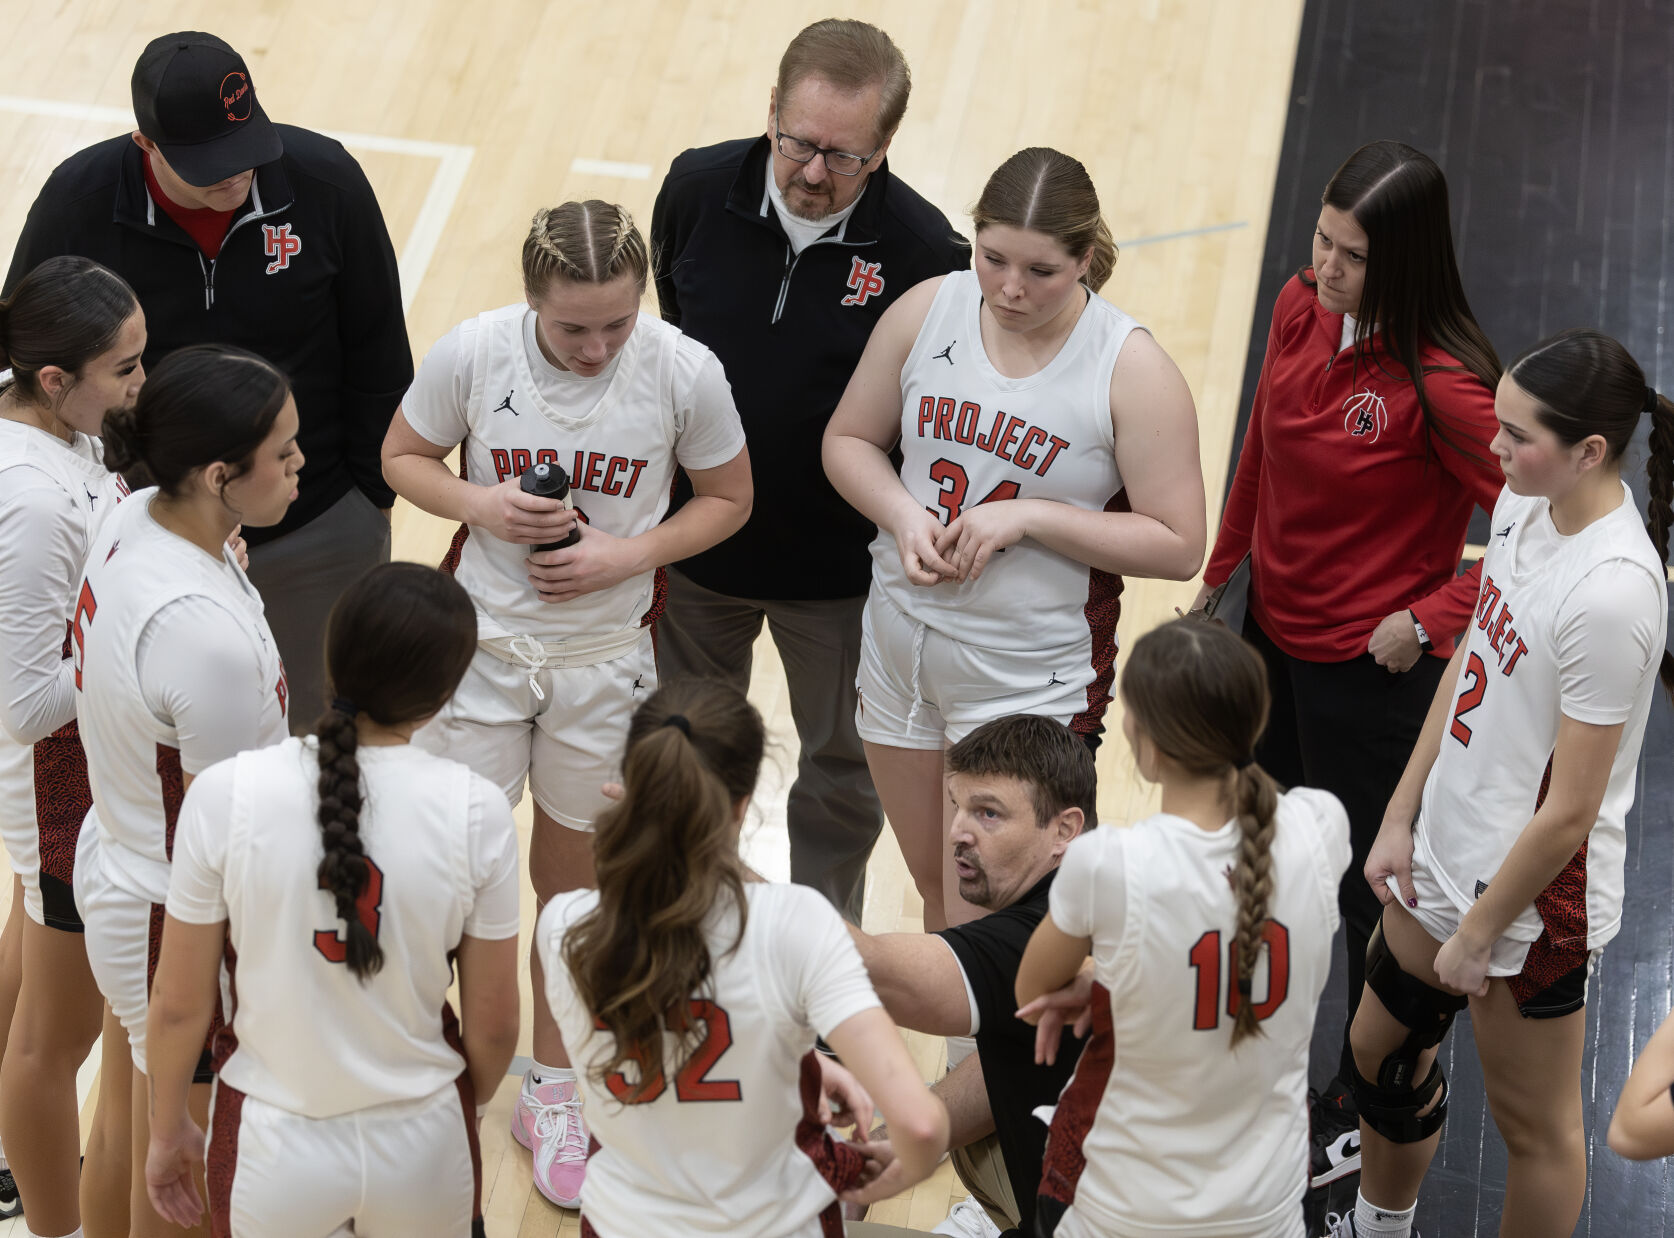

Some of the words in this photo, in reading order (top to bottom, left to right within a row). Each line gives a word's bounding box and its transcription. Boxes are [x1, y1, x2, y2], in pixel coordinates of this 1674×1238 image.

[918, 395, 1070, 477] PROJECT
[1450, 651, 1488, 748] 2
[313, 854, 384, 963] 3
[1189, 918, 1290, 1031] 10
